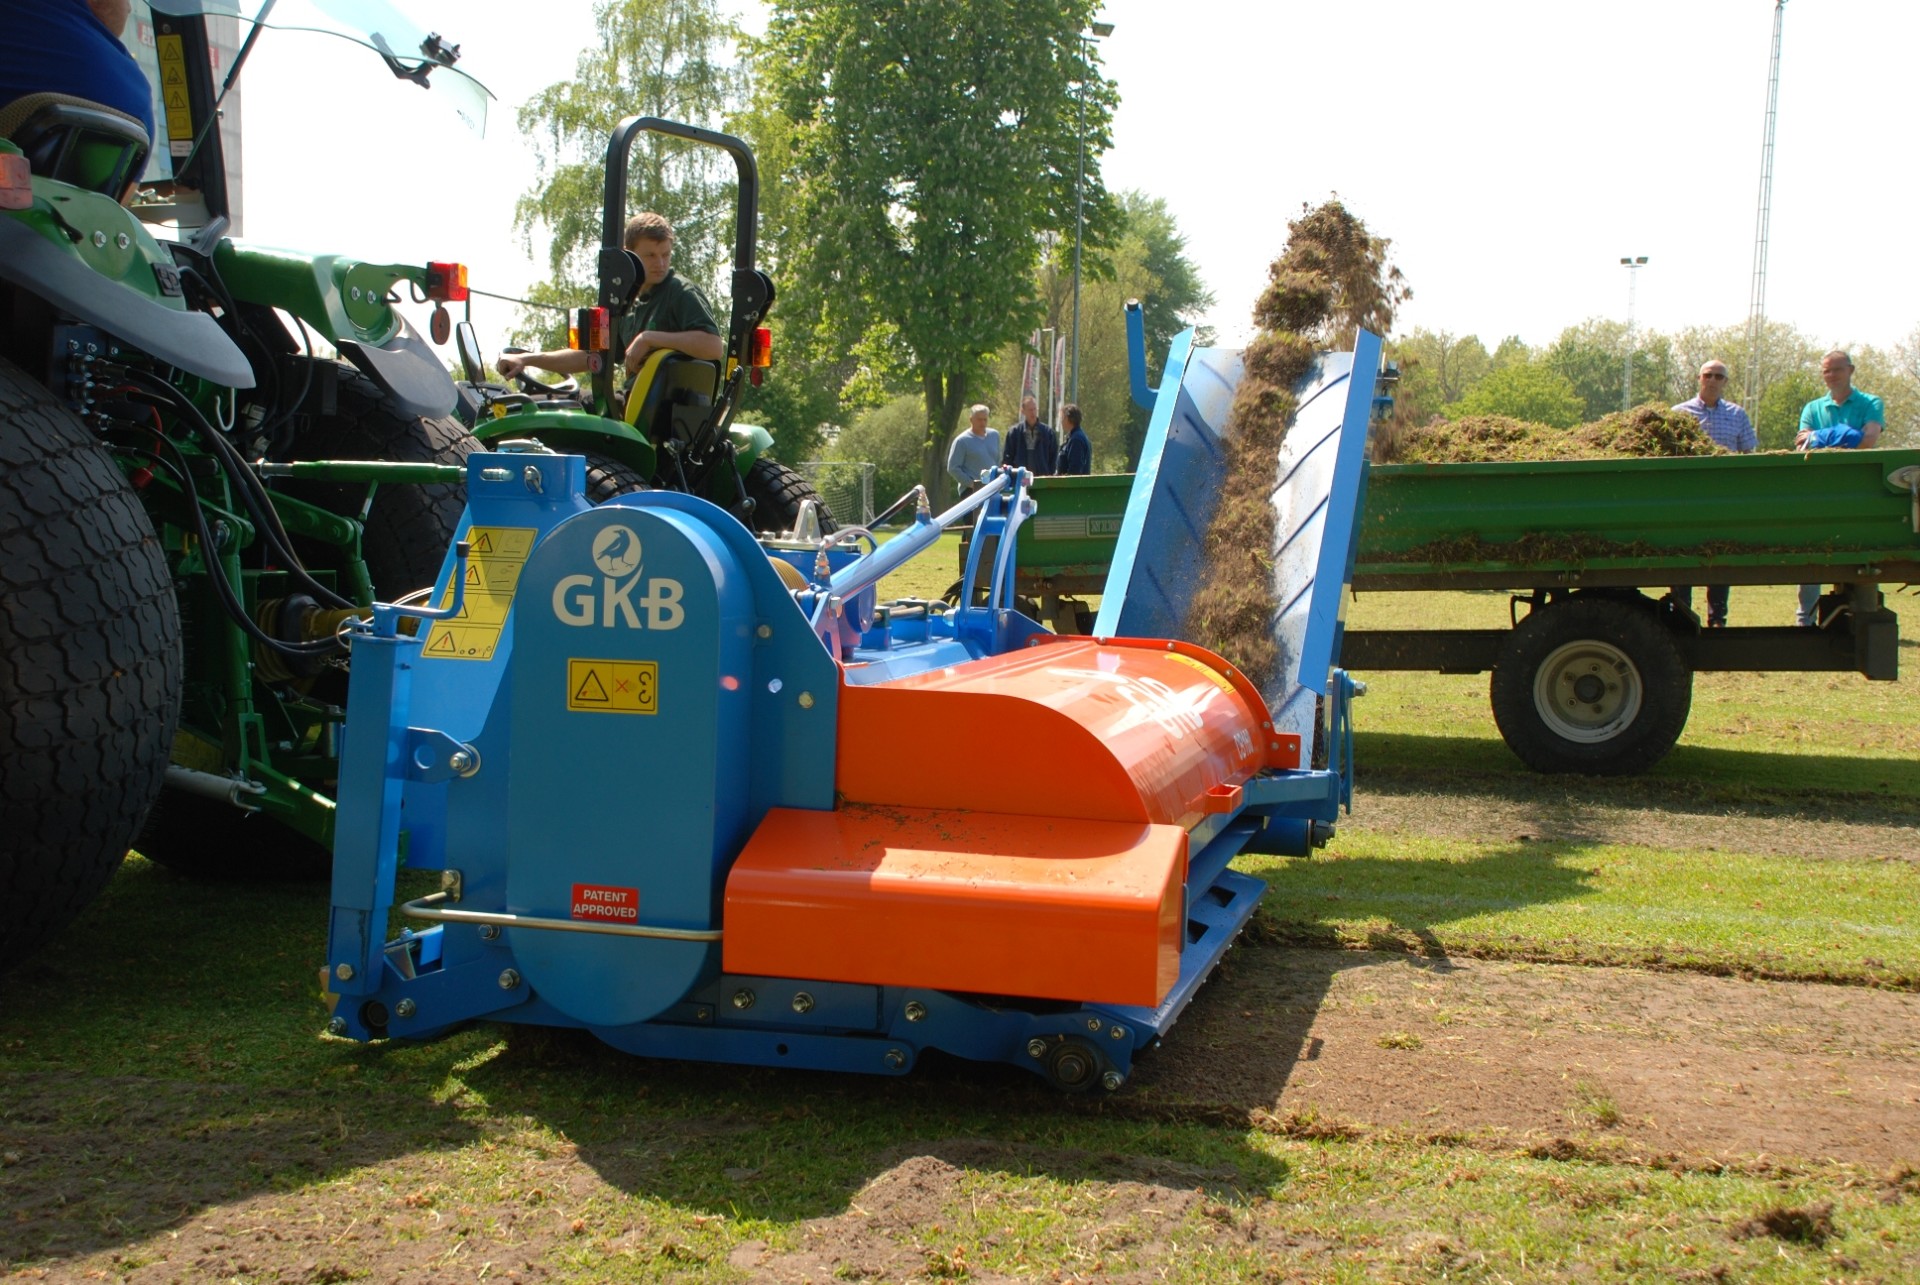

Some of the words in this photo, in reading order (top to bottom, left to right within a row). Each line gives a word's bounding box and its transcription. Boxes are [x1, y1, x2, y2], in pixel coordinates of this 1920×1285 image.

[552, 564, 686, 630] GKB
[583, 889, 628, 903] PATENT
[573, 903, 637, 918] APPROVED
